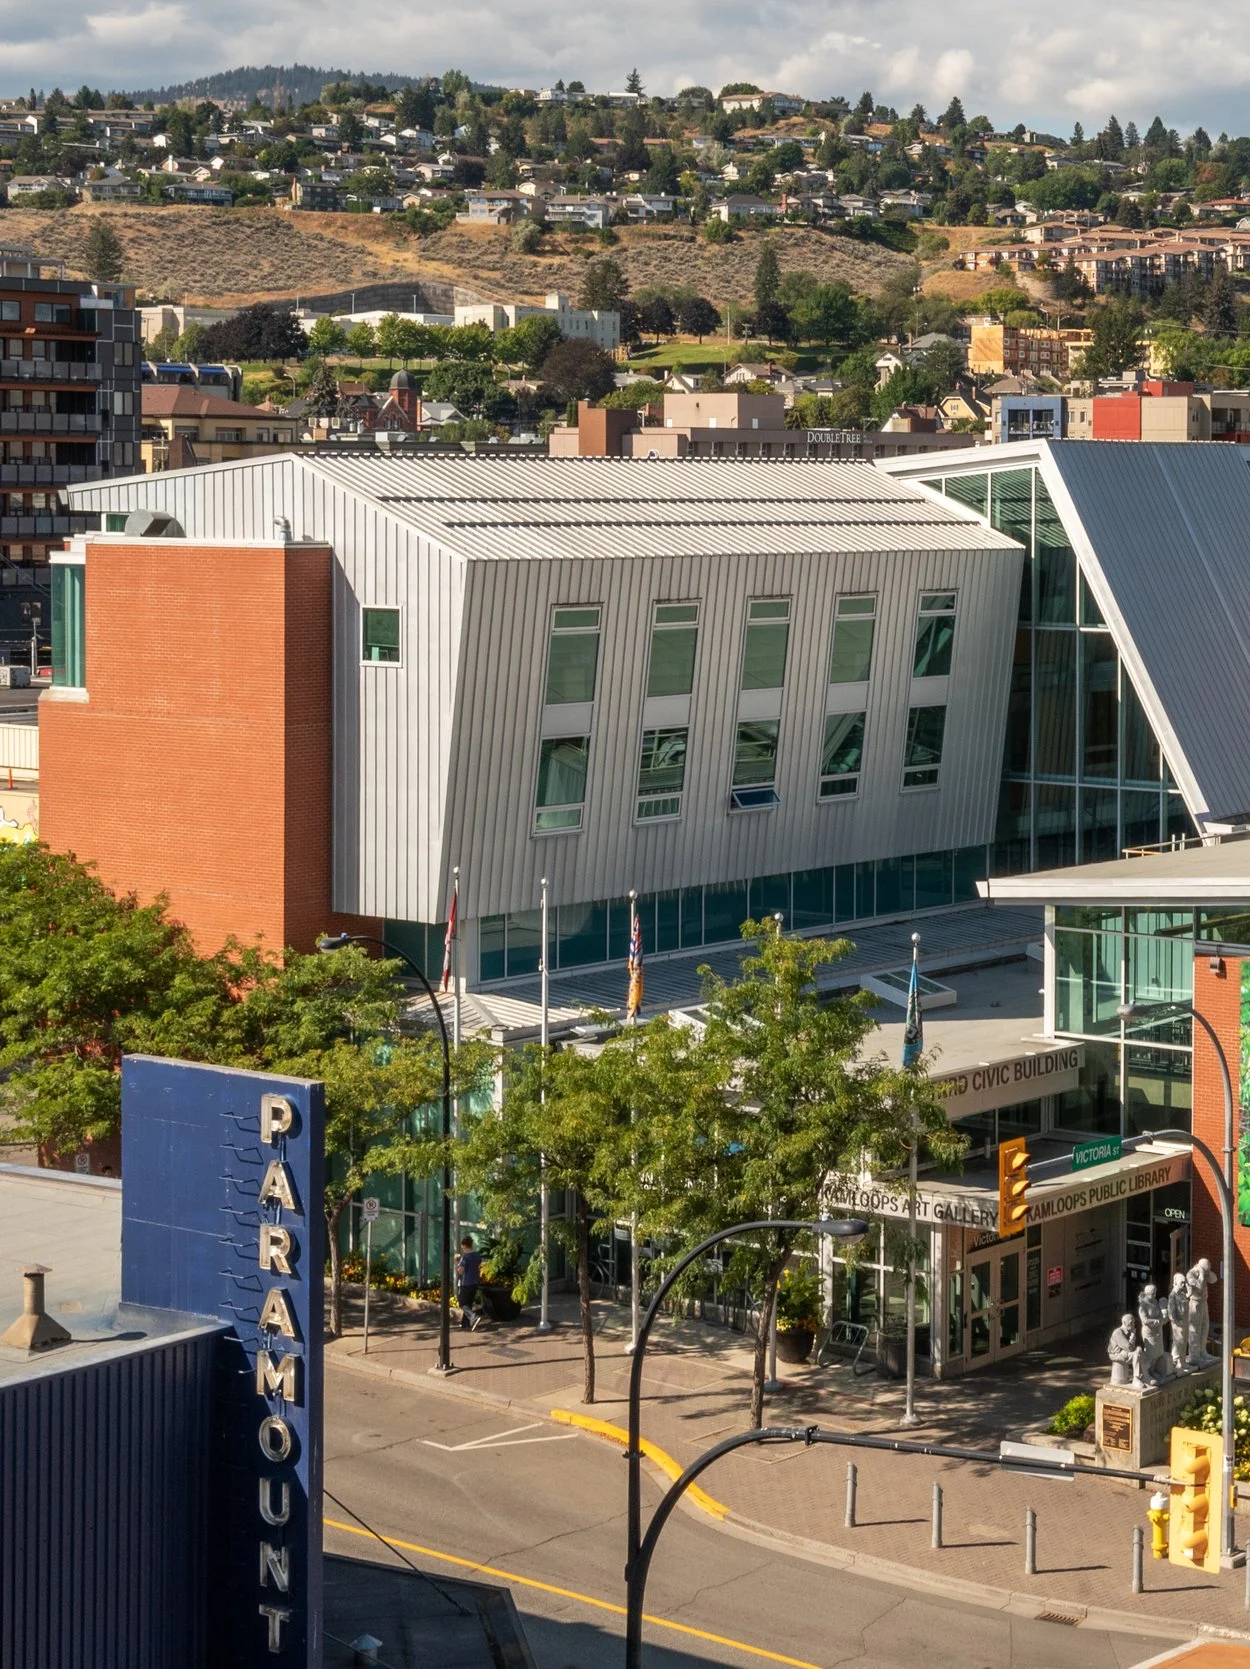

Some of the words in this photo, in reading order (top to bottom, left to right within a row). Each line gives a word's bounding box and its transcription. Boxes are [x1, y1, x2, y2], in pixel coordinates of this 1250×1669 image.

[972, 1064, 1010, 1091] CIVIC
[1014, 1050, 1079, 1082] BUILDING
[1075, 1143, 1112, 1165] VICTORIA
[1112, 1145, 1121, 1156] ST
[902, 1196, 930, 1217] ART
[933, 1203, 999, 1227] GALLERY
[1026, 1191, 1087, 1223] KAMLOOPS
[1089, 1179, 1127, 1205] PUBLIC
[1129, 1166, 1172, 1193] LIBRARY
[1164, 1207, 1186, 1219] OPEN
[255, 1094, 298, 1654] PARAMOUNT
